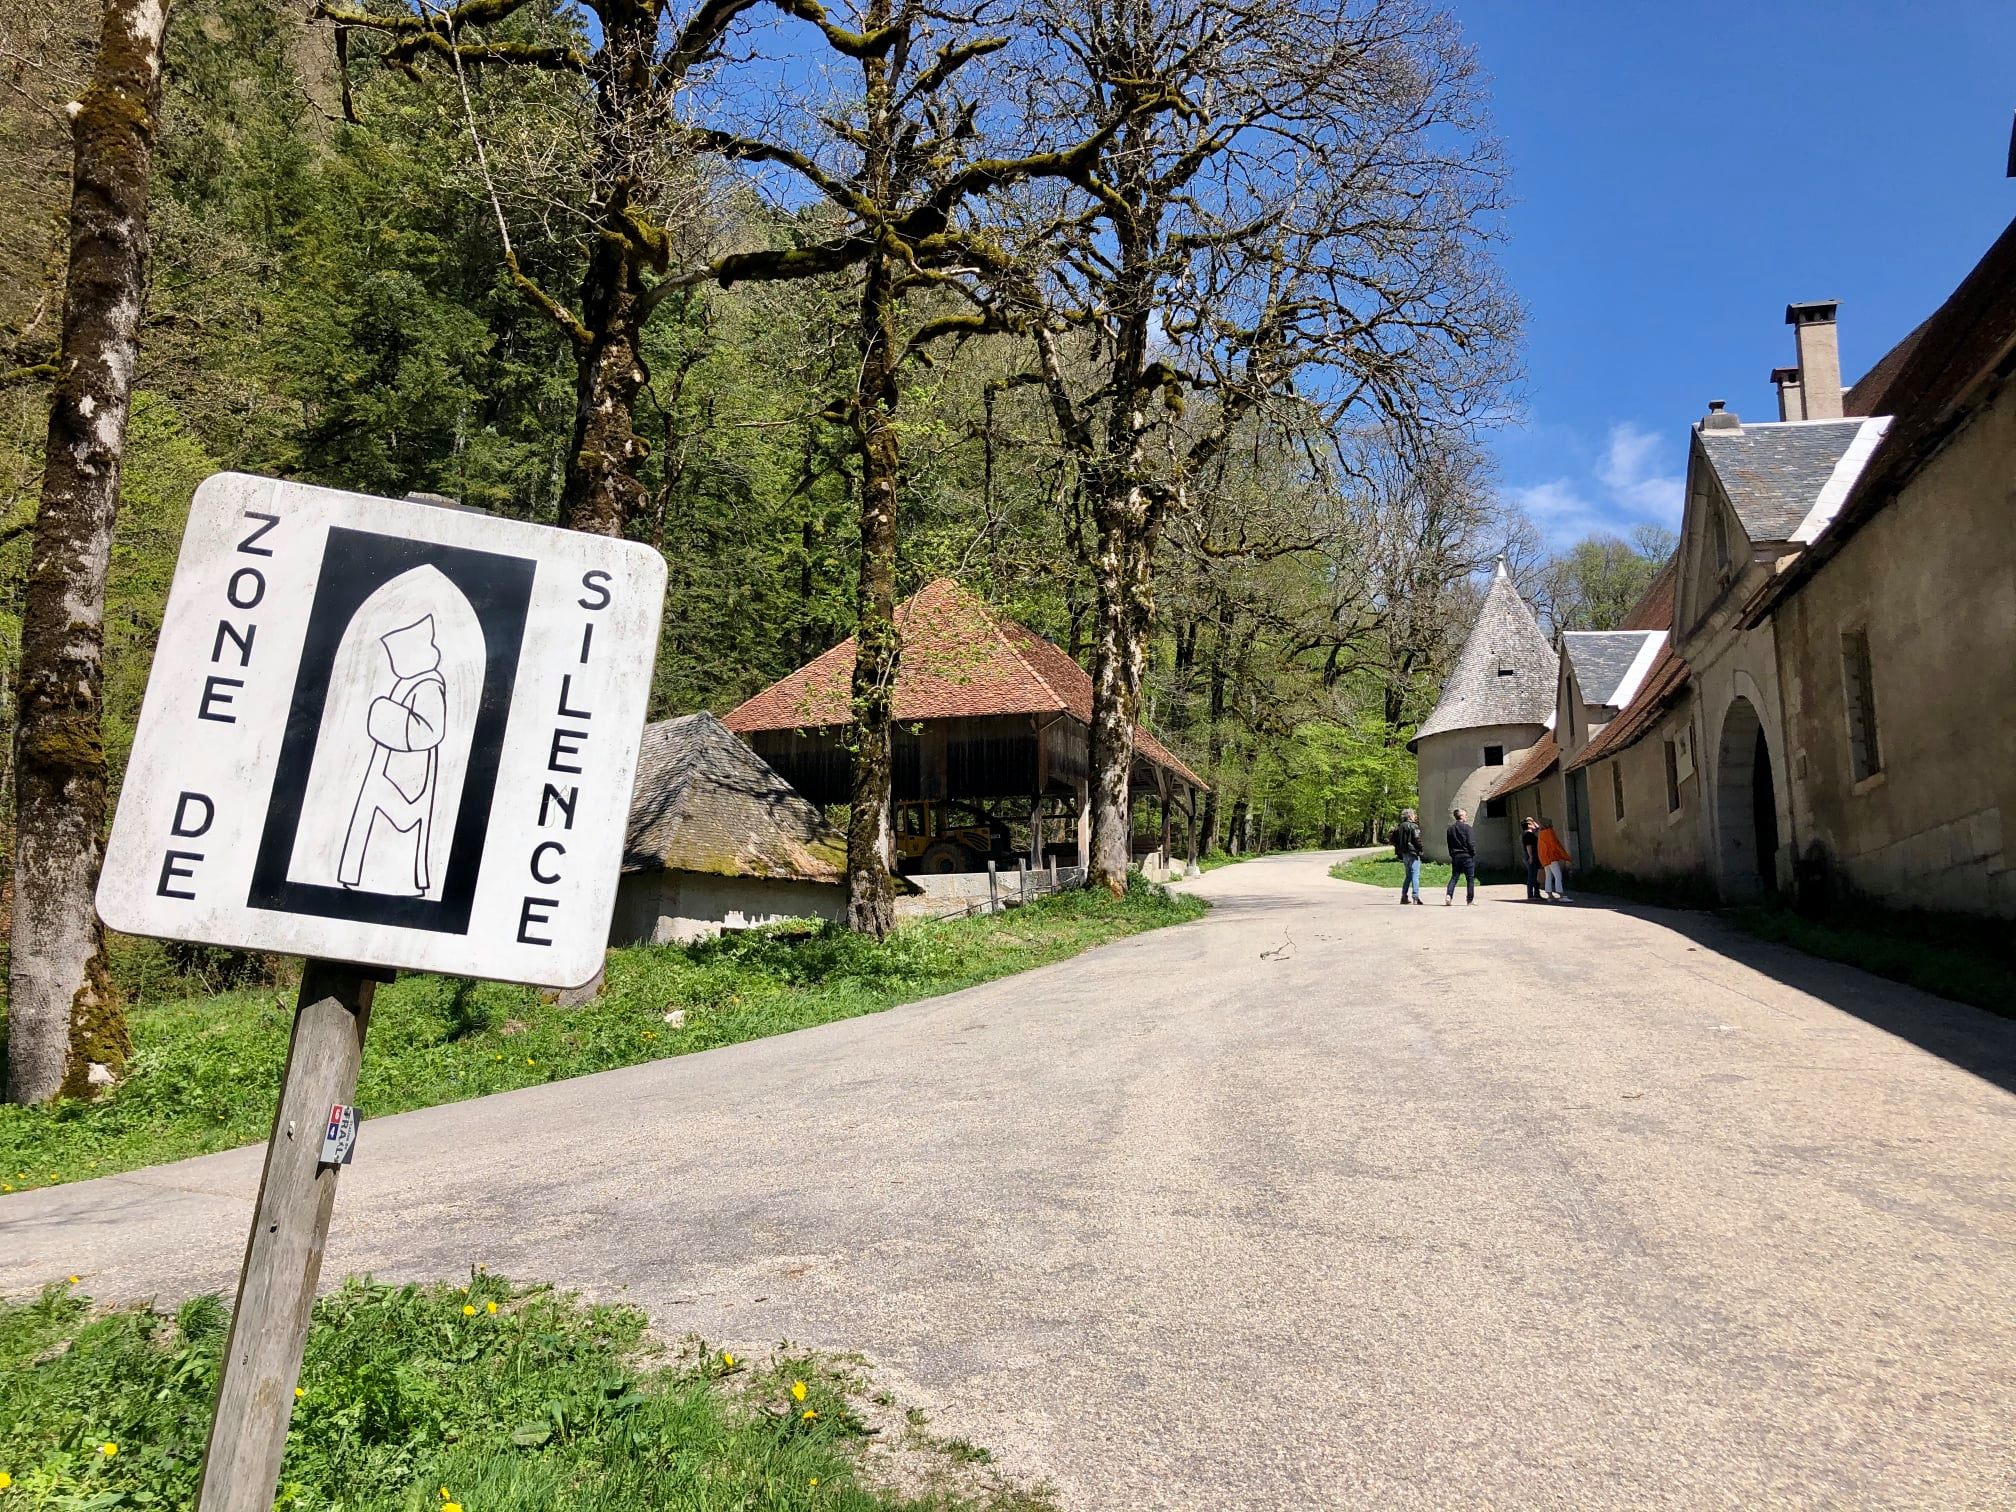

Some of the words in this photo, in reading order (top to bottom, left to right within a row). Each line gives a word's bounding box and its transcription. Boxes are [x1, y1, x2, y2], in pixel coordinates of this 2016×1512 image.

[198, 510, 281, 724] ZONE
[156, 791, 216, 901] DE
[516, 570, 613, 947] SILENCE
